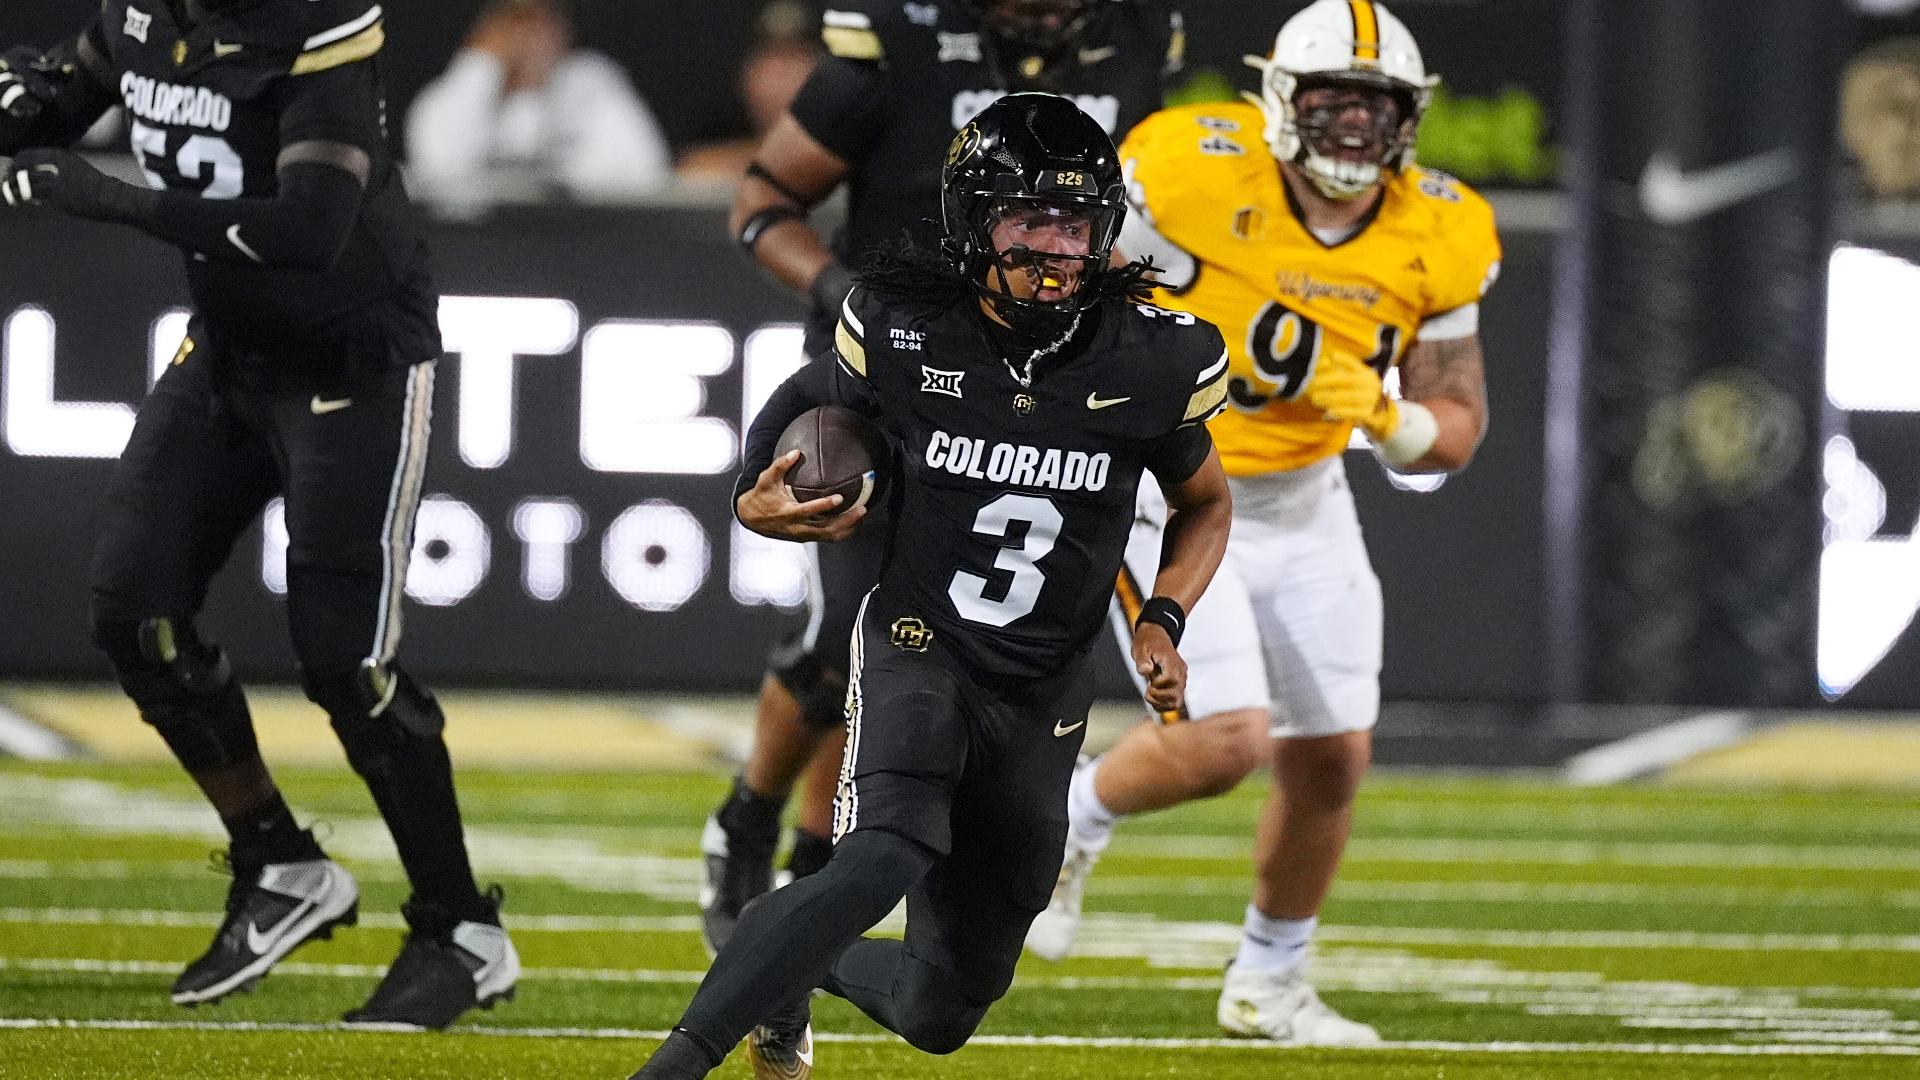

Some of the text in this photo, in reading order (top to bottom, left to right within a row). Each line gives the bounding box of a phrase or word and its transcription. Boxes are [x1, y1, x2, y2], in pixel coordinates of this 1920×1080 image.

[120, 70, 232, 132] COLORADO
[889, 327, 927, 342] mac
[893, 340, 922, 351] 82-94
[923, 369, 962, 395] XII
[926, 430, 1111, 492] COLORADO
[948, 493, 1064, 628] 3
